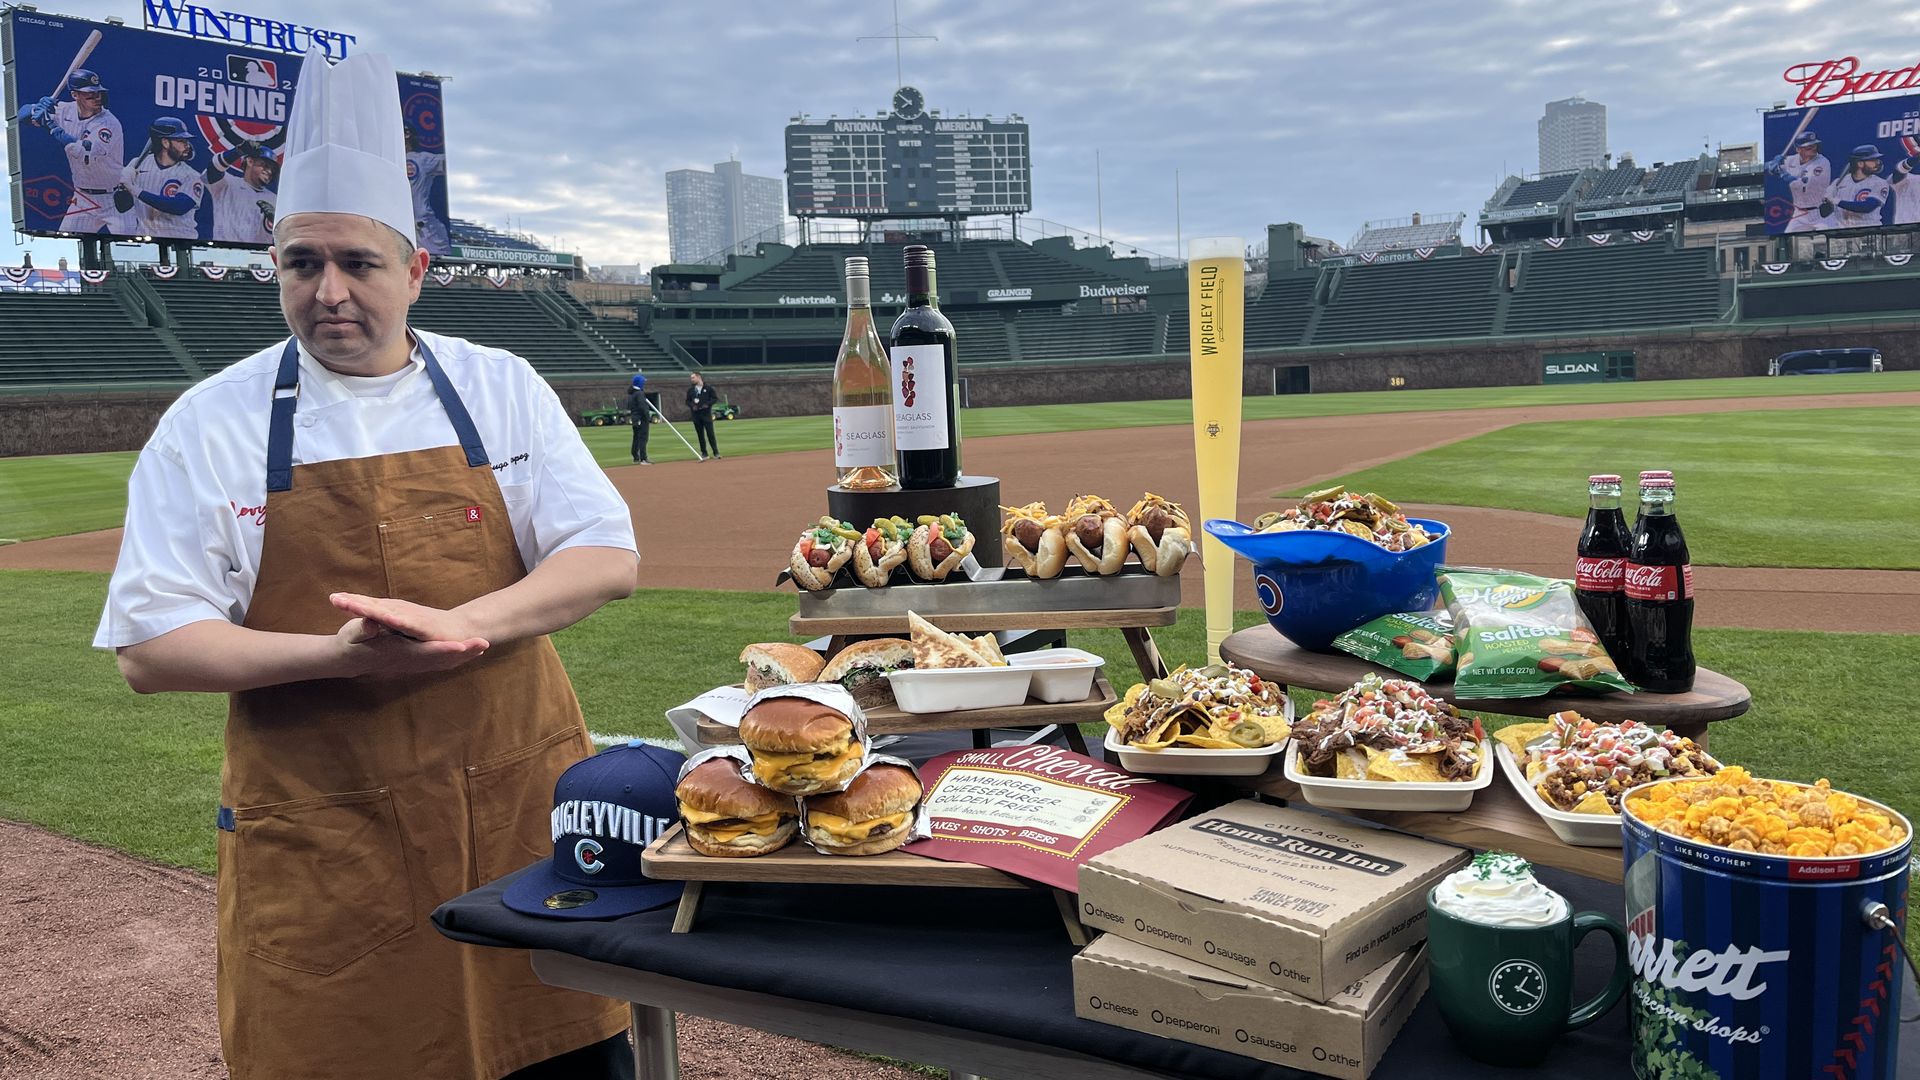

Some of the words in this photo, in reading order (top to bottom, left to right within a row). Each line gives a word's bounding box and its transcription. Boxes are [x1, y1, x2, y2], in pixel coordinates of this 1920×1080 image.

[18, 16, 46, 26] CHICAGO
[143, 0, 356, 60] WINTRUST
[198, 67, 223, 80] 20
[155, 75, 286, 121] OPENING
[834, 121, 885, 132] NATIONAL
[934, 121, 984, 131] AMERICAN
[461, 247, 558, 263] WRIGLEYROOFTOPS.COM
[987, 288, 1032, 297] GRAINGER
[1080, 284, 1149, 298] Budweiser
[1201, 266, 1218, 299] FIELD
[785, 295, 837, 305] tastytrade
[1201, 304, 1218, 355] WRIGLEY
[847, 431, 886, 441] SEAGLASS
[492, 461, 508, 471] ugo
[511, 453, 529, 465] opez
[470, 509, 478, 519] &
[1480, 625, 1561, 642] salted
[1485, 640, 1529, 651] ROASTED
[1472, 667, 1484, 675] NET
[1506, 666, 1515, 674] OZ
[1516, 666, 1536, 675] (227g)
[957, 753, 1004, 766] SMALL
[1003, 745, 1156, 789] Cheval
[950, 775, 1042, 794] HAMBURGER
[935, 796, 994, 805] GOLDEN
[993, 800, 1043, 813] FRIES
[942, 785, 1061, 806] CHEESEBURGER
[551, 800, 669, 847] RIGLEYVILLE
[930, 821, 961, 831] AKES
[970, 824, 1010, 837] SHOTS
[1018, 829, 1059, 845] BEERS
[1264, 823, 1365, 849] CHICAGO'S
[574, 838, 605, 875] C
[1198, 820, 1278, 844] Home
[1276, 837, 1337, 859] Run
[1335, 852, 1392, 874] Inn
[1213, 838, 1264, 860] PREMIUM
[1266, 857, 1339, 871] PIZZERIA
[1674, 845, 1693, 857] LIKE
[1696, 851, 1709, 860] NO
[1160, 843, 1218, 861] AUTHENTIC
[1219, 858, 1268, 874] CHICAGO
[1271, 871, 1297, 882] THIN
[1299, 879, 1338, 892] CRUST
[1799, 866, 1835, 874] Addison
[1249, 894, 1290, 909] SINCE
[1292, 901, 1325, 917] 1947
[1257, 889, 1294, 901] FAMILY
[1293, 896, 1330, 909] OWNED
[1095, 908, 1125, 924] cheese
[1146, 925, 1192, 946] pepperoni
[1216, 947, 1256, 966] sausage
[1283, 968, 1311, 984] other
[1345, 946, 1361, 963] Find
[1361, 943, 1369, 955] us
[1370, 938, 1377, 949] in
[1377, 929, 1391, 947] your
[1391, 917, 1406, 936] local
[1628, 930, 1790, 1001] arrett
[1103, 1000, 1139, 1017] cheese
[1165, 1015, 1220, 1036] pepperoni
[1250, 1034, 1297, 1053] sausage
[1328, 1051, 1360, 1069] other
